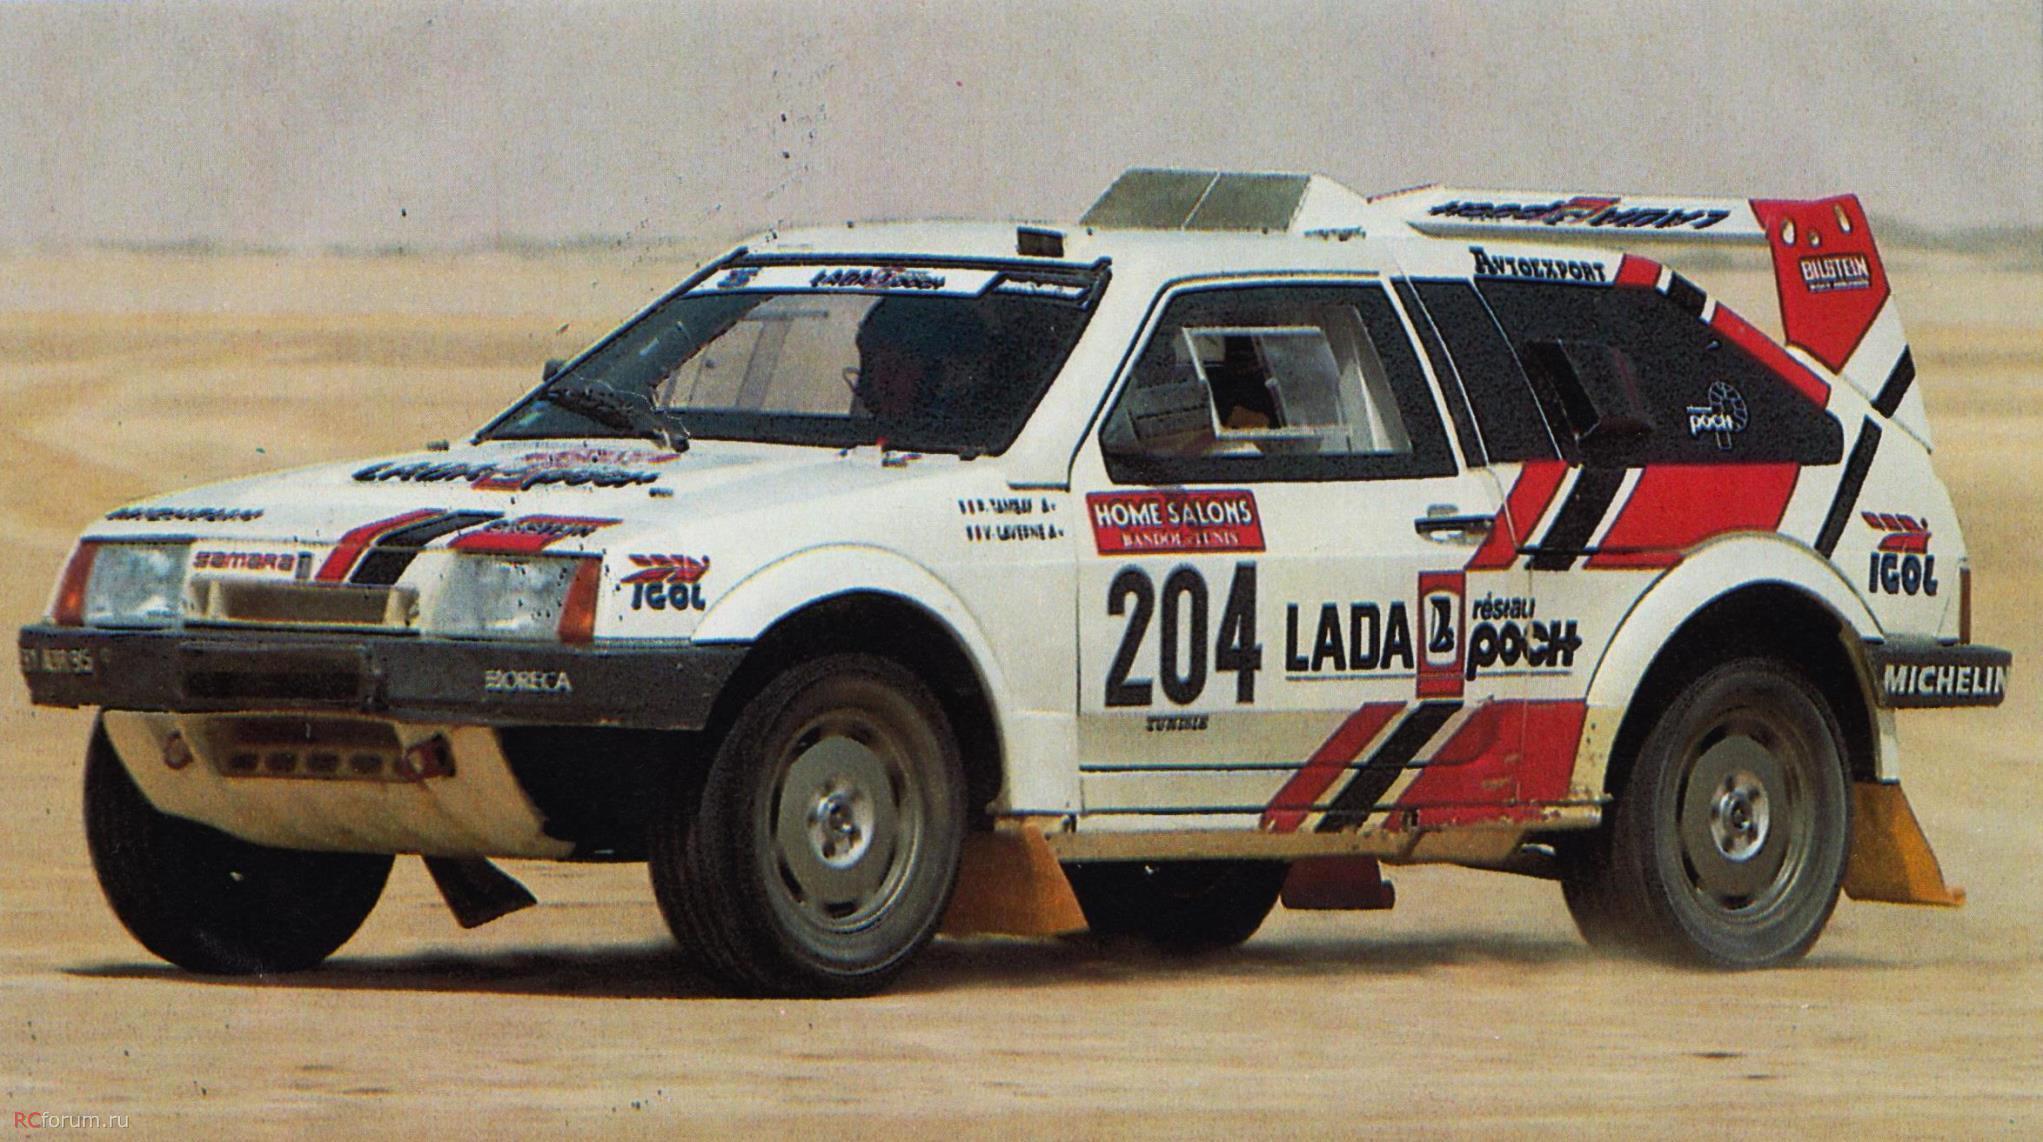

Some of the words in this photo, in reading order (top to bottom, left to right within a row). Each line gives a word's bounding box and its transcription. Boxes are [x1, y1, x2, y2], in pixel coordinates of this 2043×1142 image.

[1800, 256, 1870, 281] BILSTEIN
[1094, 502, 1163, 527] HOME
[1167, 500, 1253, 525] SALONS
[1869, 551, 1938, 596] IGOL
[629, 582, 706, 612] IGOL
[1104, 561, 1262, 708] 204
[1285, 602, 1415, 672] LADA
[1884, 664, 2009, 693] MICHELIN
